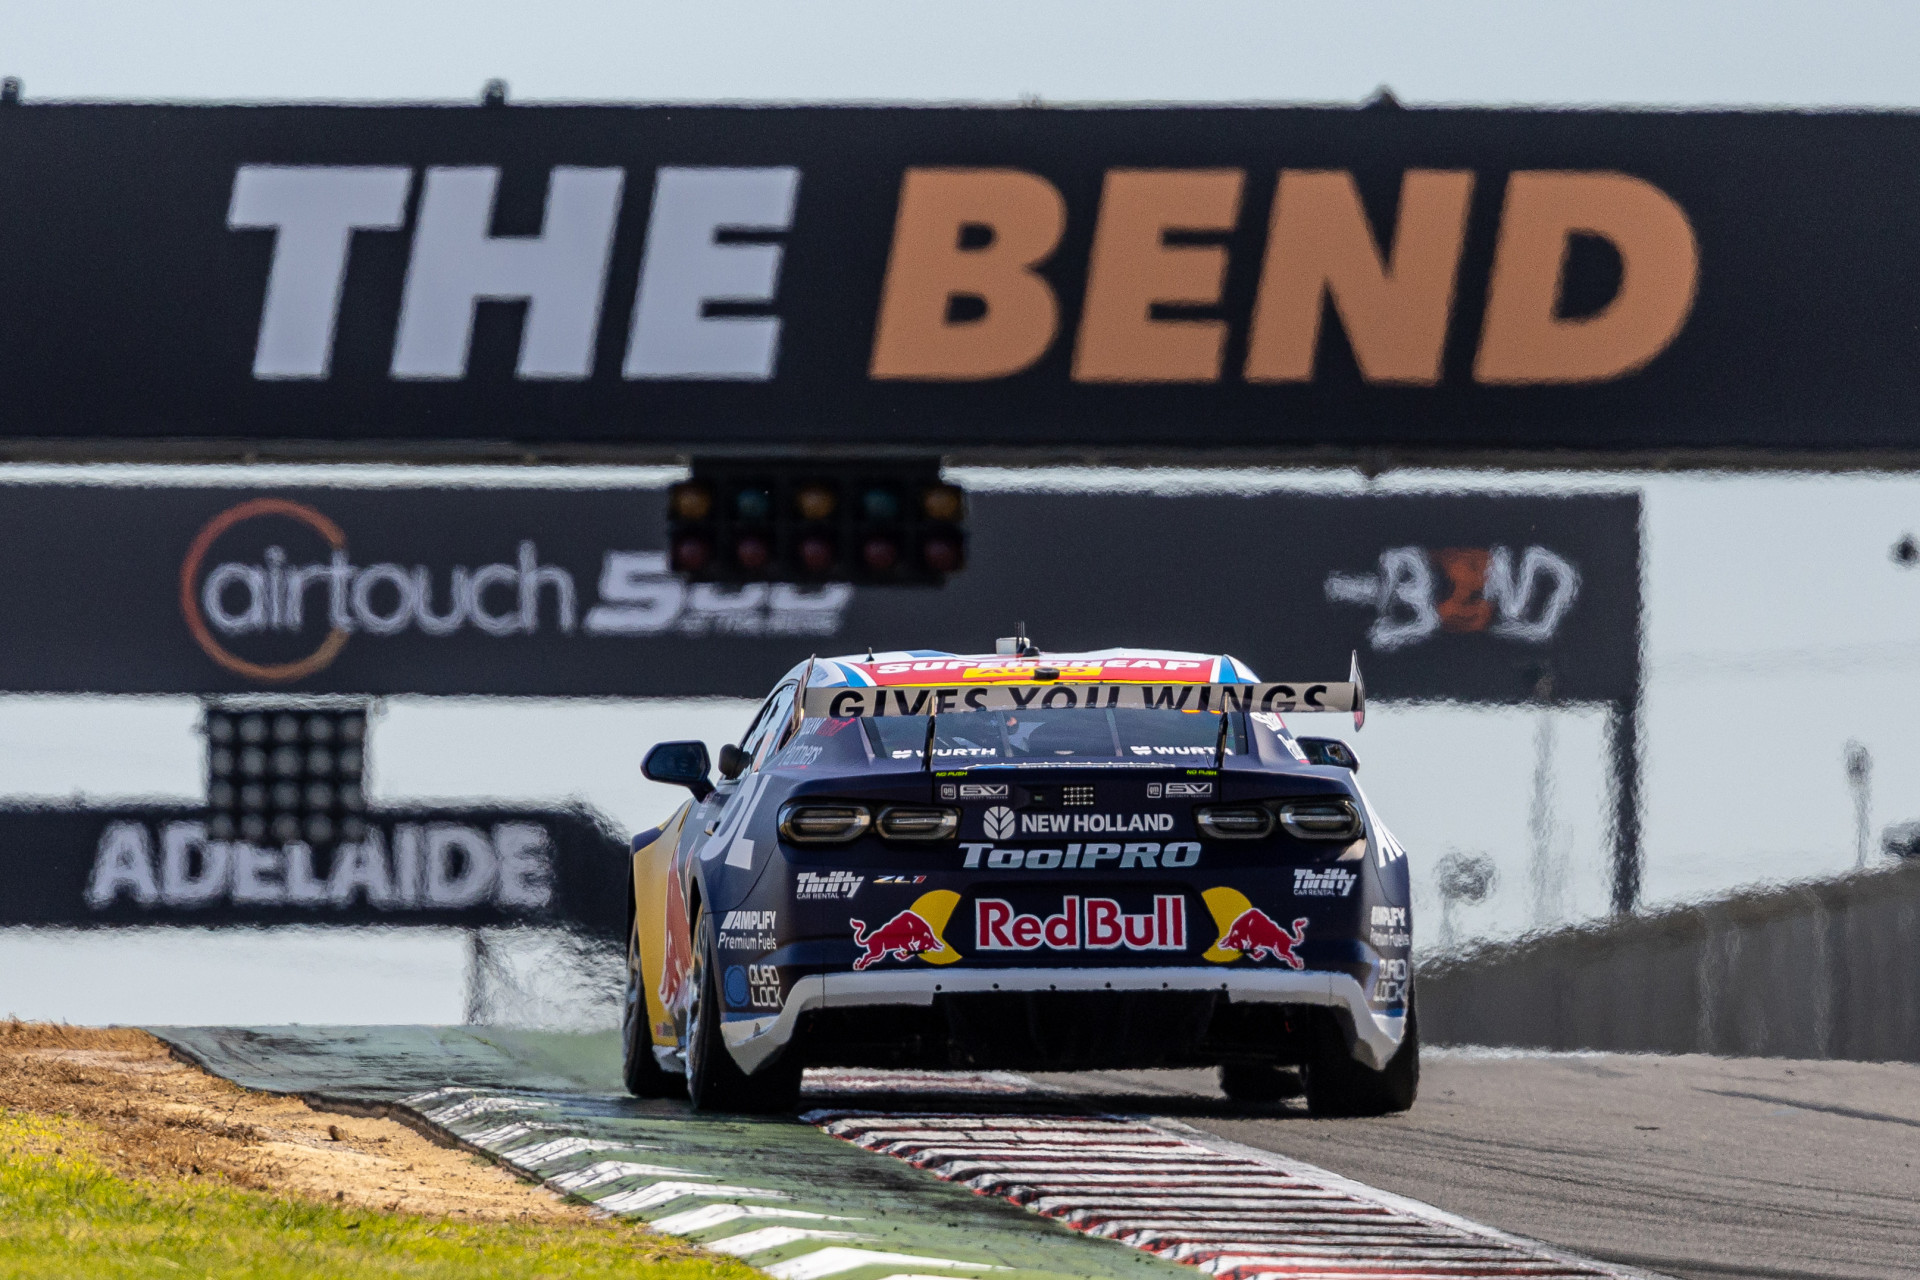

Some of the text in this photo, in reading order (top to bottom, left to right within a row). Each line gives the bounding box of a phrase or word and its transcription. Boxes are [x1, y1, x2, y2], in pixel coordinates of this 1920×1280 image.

[227, 165, 1700, 385] THE BEND
[204, 540, 577, 634] airtouch
[829, 685, 1327, 718] GIVES YOU WINGS
[1022, 814, 1174, 832] NEW HOLLAND
[92, 821, 554, 905] ADELAIDE
[797, 871, 864, 898] Thrifty
[873, 875, 927, 883] ZL1
[1293, 868, 1357, 896] Thrifty
[731, 911, 776, 929] AMPLIFY
[976, 895, 1186, 950] Red Bull
[718, 932, 776, 950] Premium Fuels
[749, 964, 779, 986] QUAD
[751, 986, 785, 1008] LOCK
